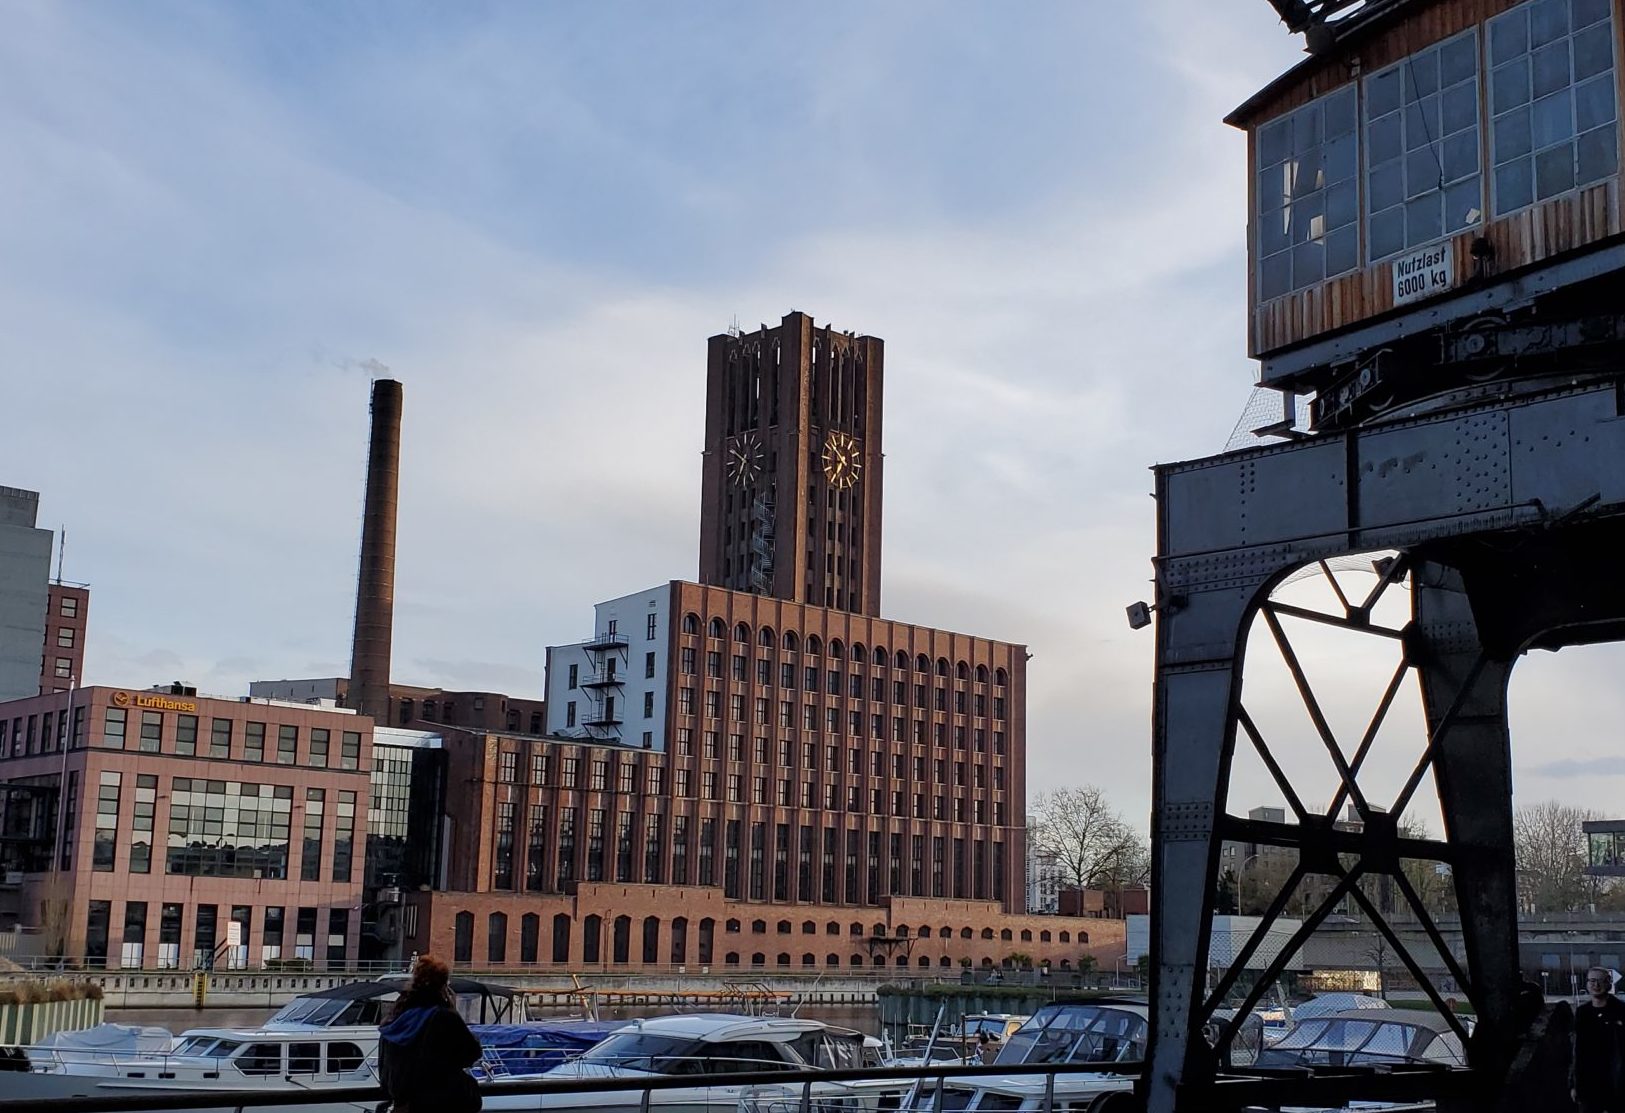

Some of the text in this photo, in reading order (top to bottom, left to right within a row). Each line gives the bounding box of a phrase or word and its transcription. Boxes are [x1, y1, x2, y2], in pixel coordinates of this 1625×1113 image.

[1397, 245, 1446, 278] Nutzlast
[1397, 269, 1447, 297] 6000 kg
[136, 694, 196, 712] Lufthansa
